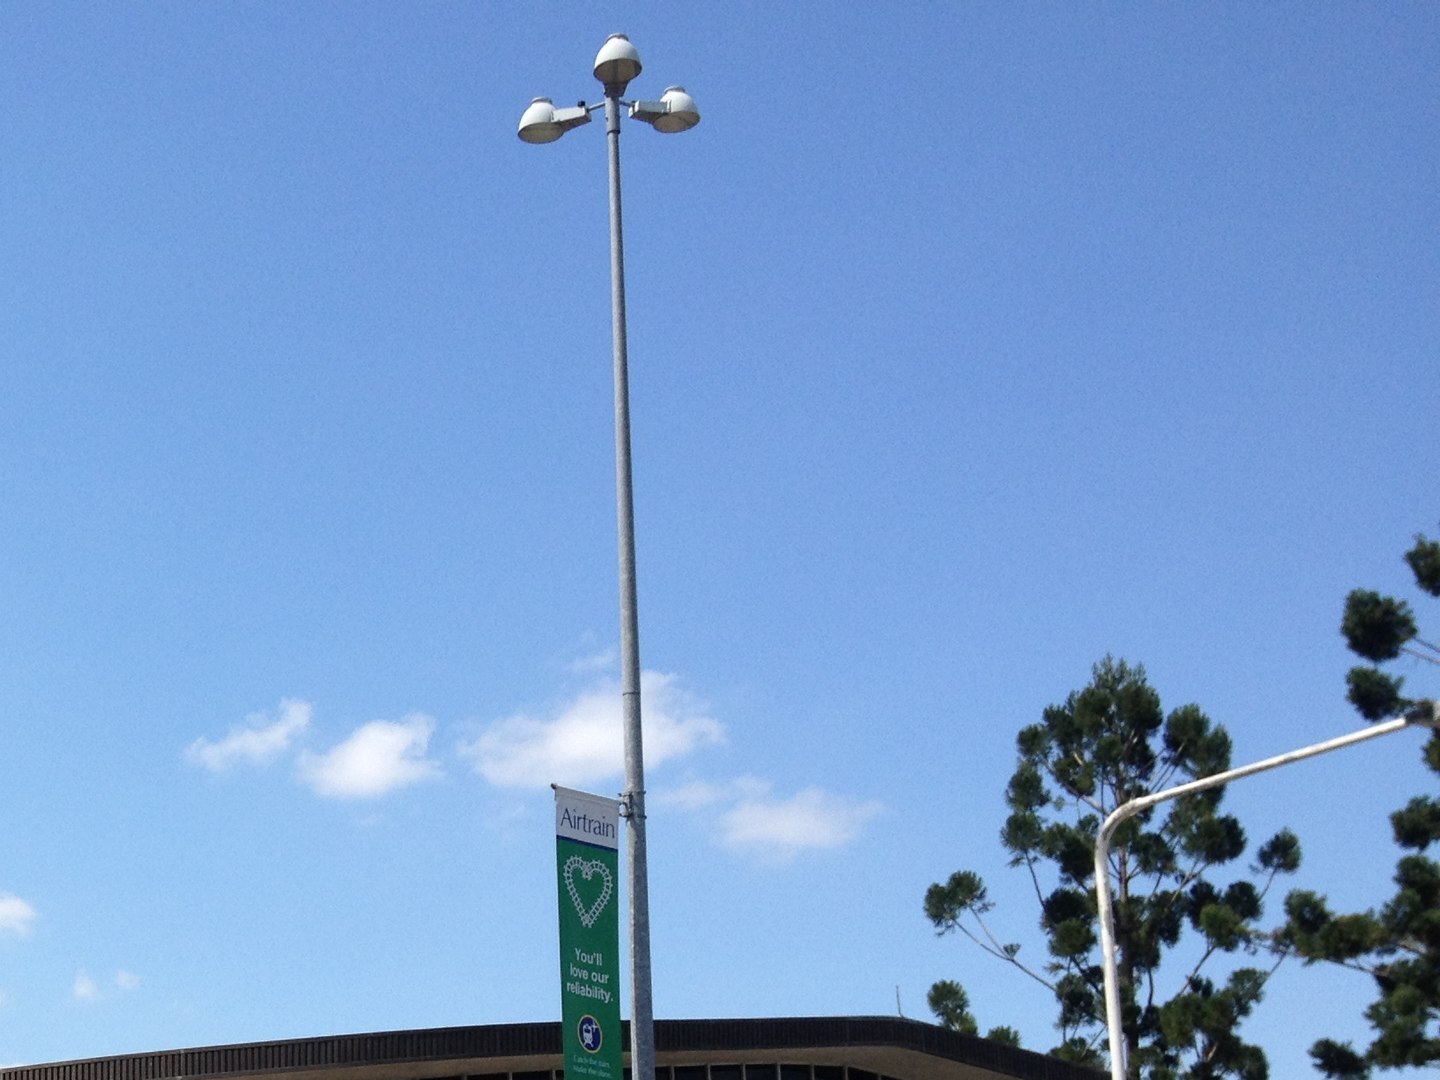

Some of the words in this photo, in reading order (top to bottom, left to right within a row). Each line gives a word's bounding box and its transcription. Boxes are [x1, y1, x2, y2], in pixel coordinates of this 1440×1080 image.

[560, 807, 615, 839] Airtrain
[575, 947, 602, 966] You'll
[570, 962, 588, 980] love
[591, 972, 609, 984] our
[566, 981, 613, 1004] reliability.
